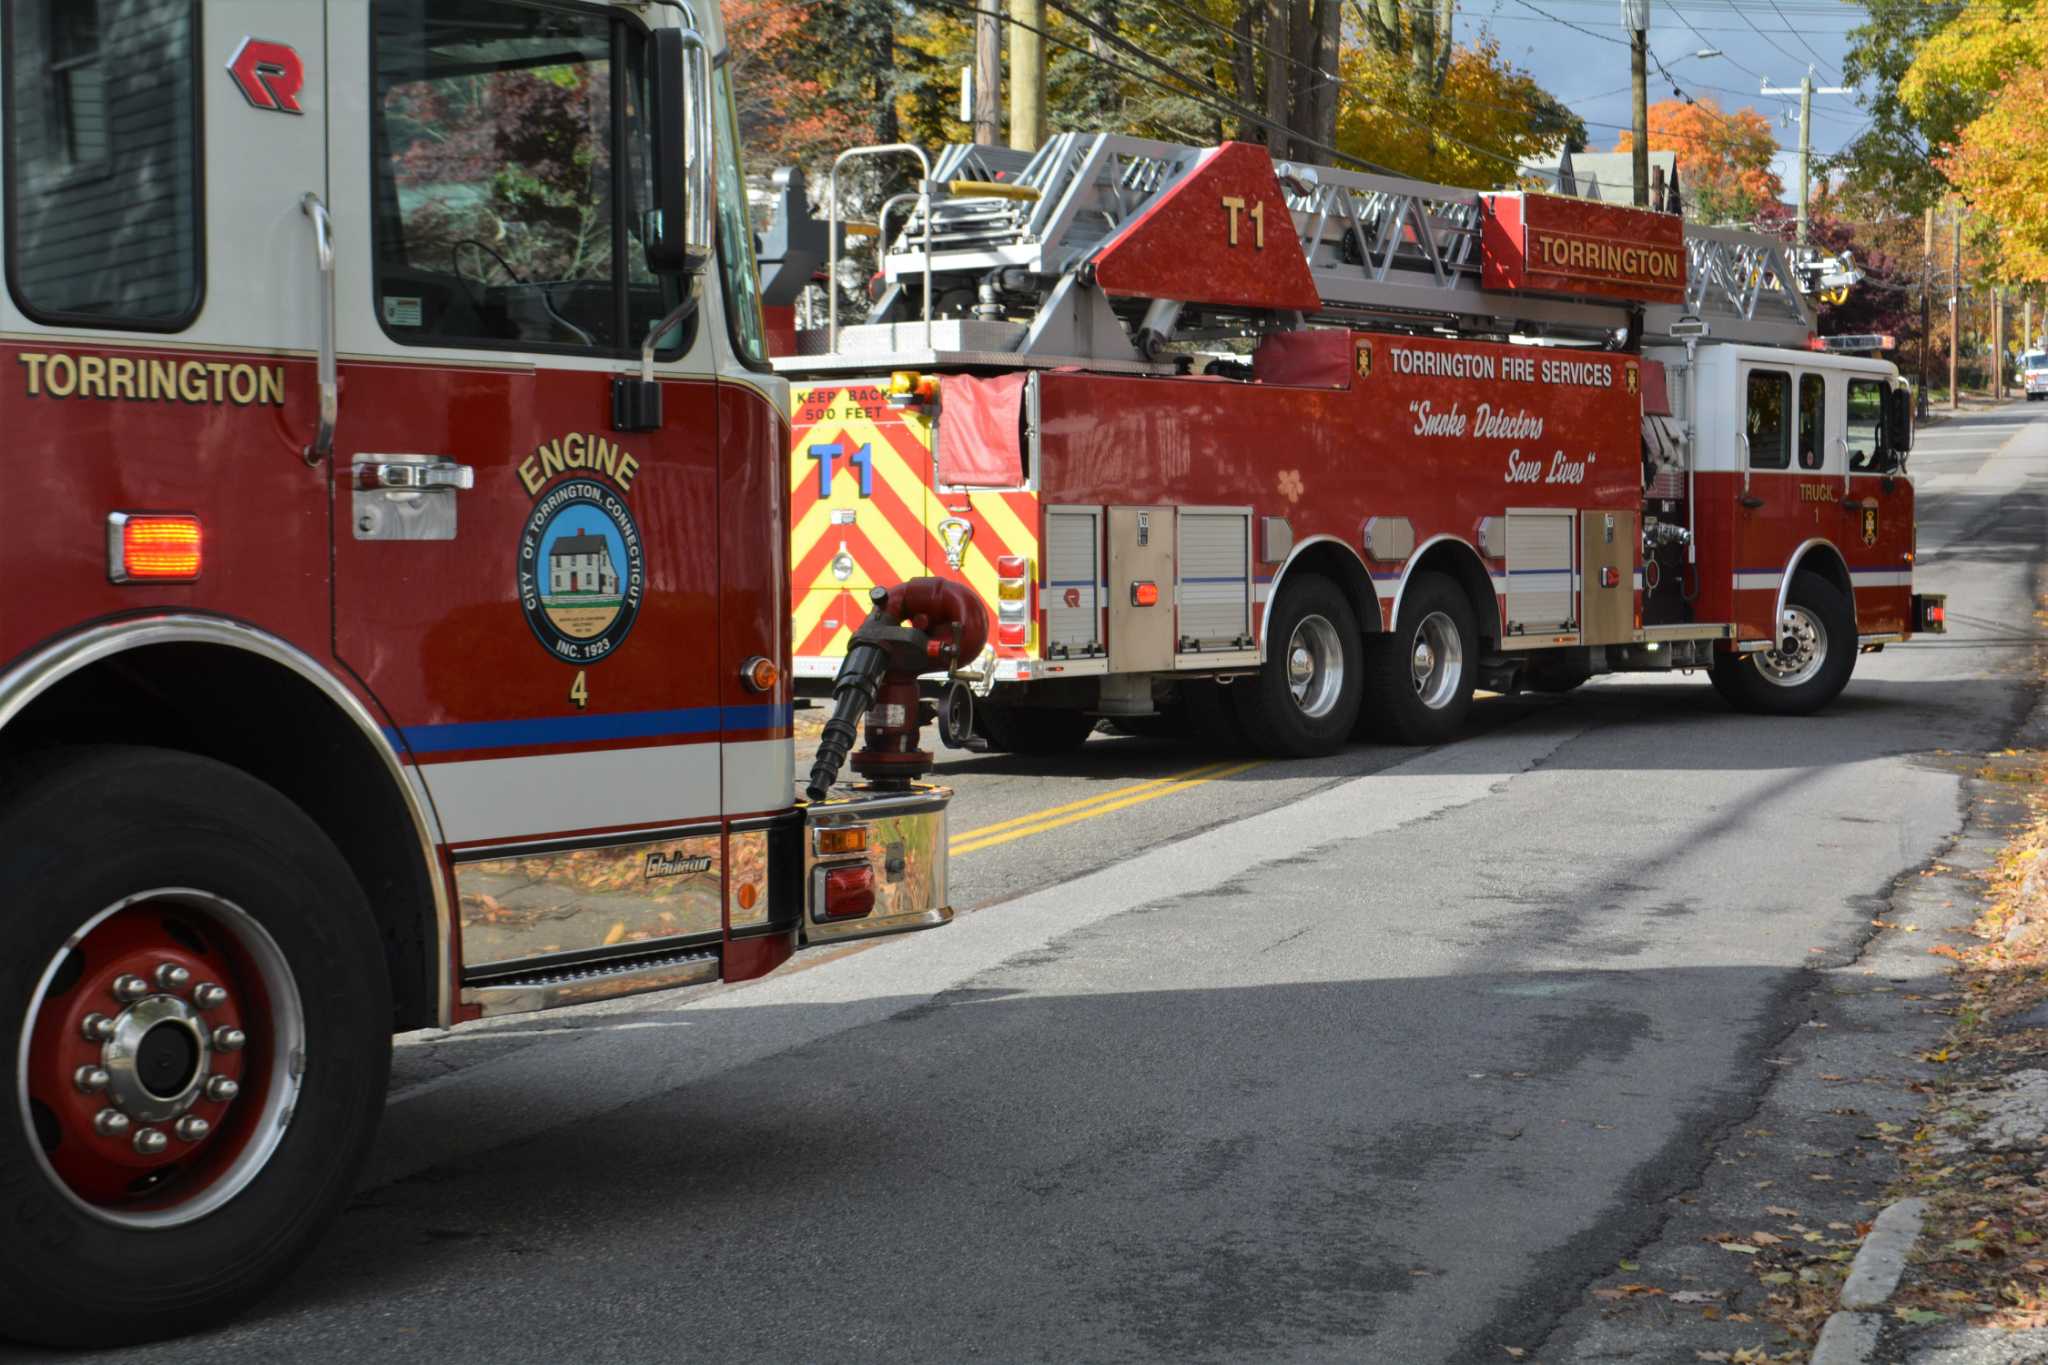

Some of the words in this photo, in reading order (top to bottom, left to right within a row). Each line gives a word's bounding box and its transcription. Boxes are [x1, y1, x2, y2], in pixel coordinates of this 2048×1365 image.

[1222, 195, 1265, 249] T1
[1539, 235, 1679, 279] TORRINGTON
[19, 352, 286, 406] TORRINGTON
[1390, 347, 1496, 380] TORRINGTON
[1501, 356, 1535, 383] FIRE
[1541, 361, 1613, 387] SERVICES
[797, 391, 836, 404] KEEP
[848, 388, 889, 402] BACK
[805, 408, 836, 420] 500
[845, 406, 883, 419] FEET
[1473, 403, 1544, 440] Detectors
[518, 431, 640, 496] ENGINE
[807, 442, 872, 499] T1
[1504, 449, 1542, 484] Save
[530, 484, 603, 533] TORRINGTON,
[1800, 484, 1834, 502] TRUCK
[1813, 507, 1819, 523] 1
[522, 536, 535, 559] OF
[605, 496, 641, 610] CONNECTICUT
[523, 572, 536, 611] CITY
[556, 639, 581, 658] INC.
[584, 638, 610, 657] 1923
[570, 670, 588, 707] 4
